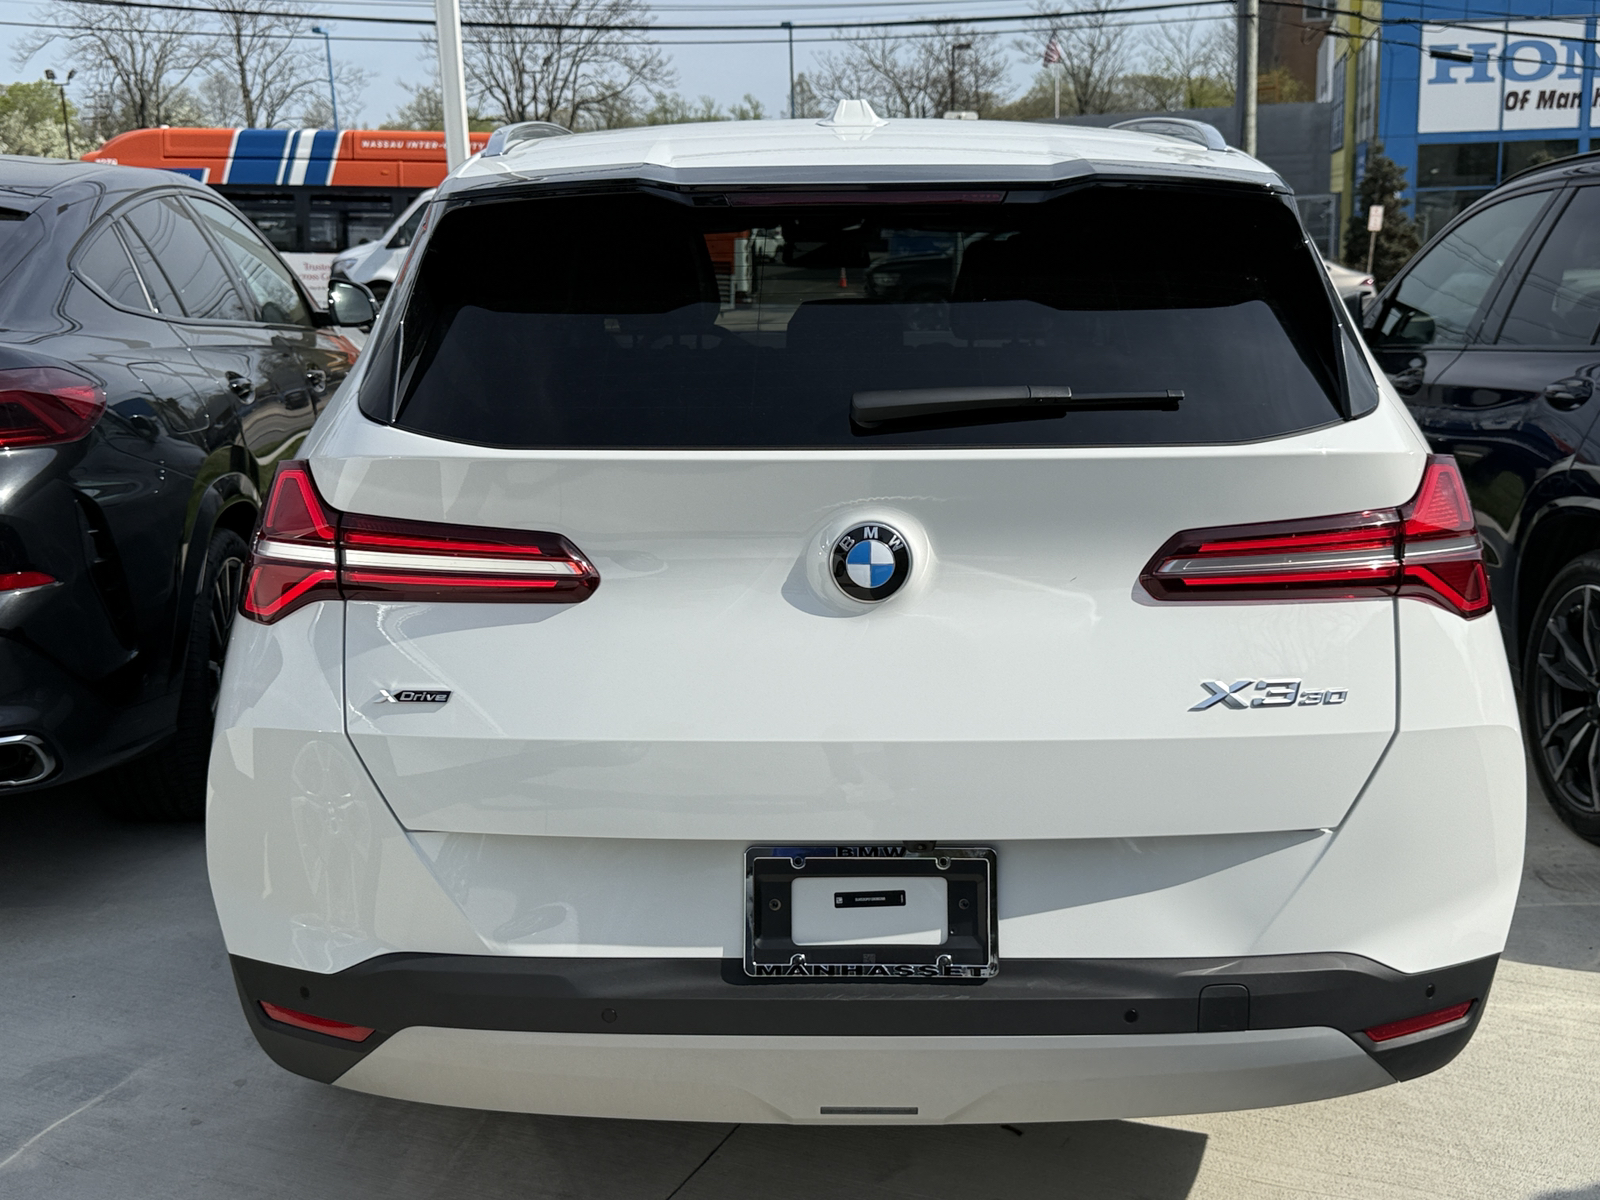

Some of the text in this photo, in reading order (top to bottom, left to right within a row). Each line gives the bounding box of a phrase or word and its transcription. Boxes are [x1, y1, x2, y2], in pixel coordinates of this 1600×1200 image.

[1504, 89, 1531, 111] Of
[839, 526, 904, 552] BMW
[837, 846, 906, 858] BMW
[754, 964, 989, 977] MANHASSET
